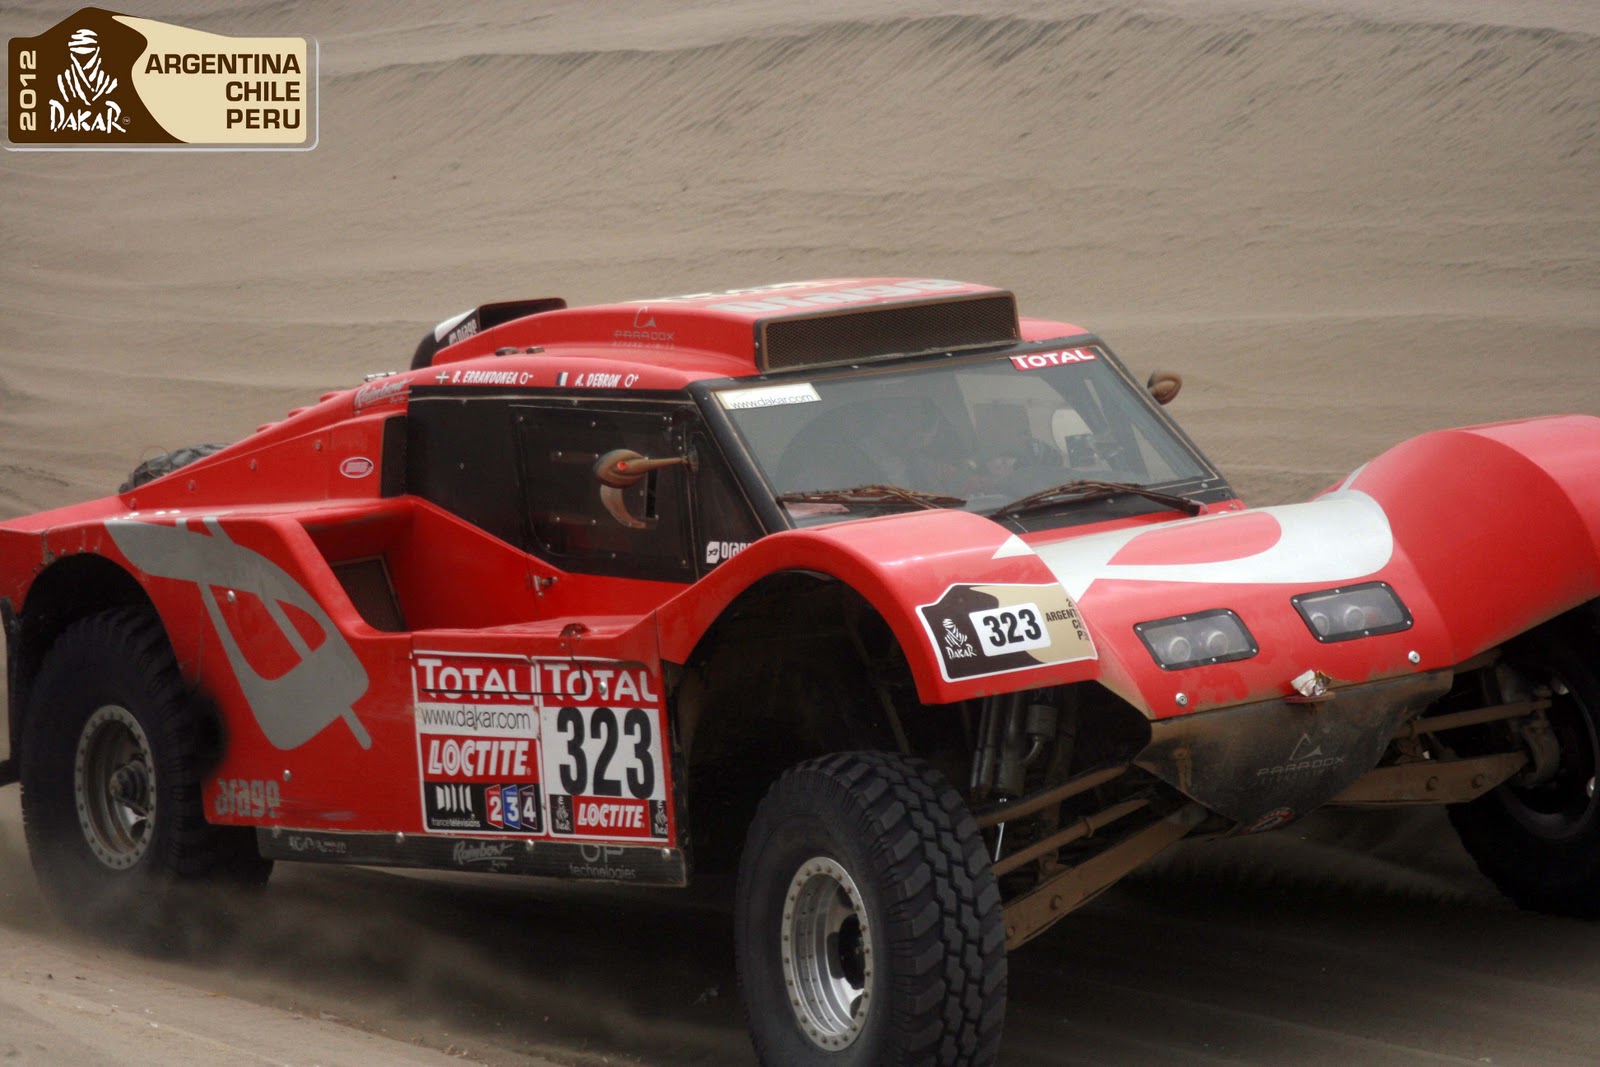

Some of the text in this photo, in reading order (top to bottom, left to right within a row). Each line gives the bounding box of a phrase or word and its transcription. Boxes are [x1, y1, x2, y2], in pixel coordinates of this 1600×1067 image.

[1013, 349, 1094, 369] TOTAL
[731, 394, 815, 409] www.dakar.com
[983, 608, 1042, 647] 323
[418, 658, 537, 700] TOTAL
[544, 664, 659, 703] TOTAL
[422, 705, 532, 730] www.dakar.com
[427, 738, 530, 777] LOCTITE
[556, 707, 656, 800] 323
[577, 803, 645, 828] LOCTITE
